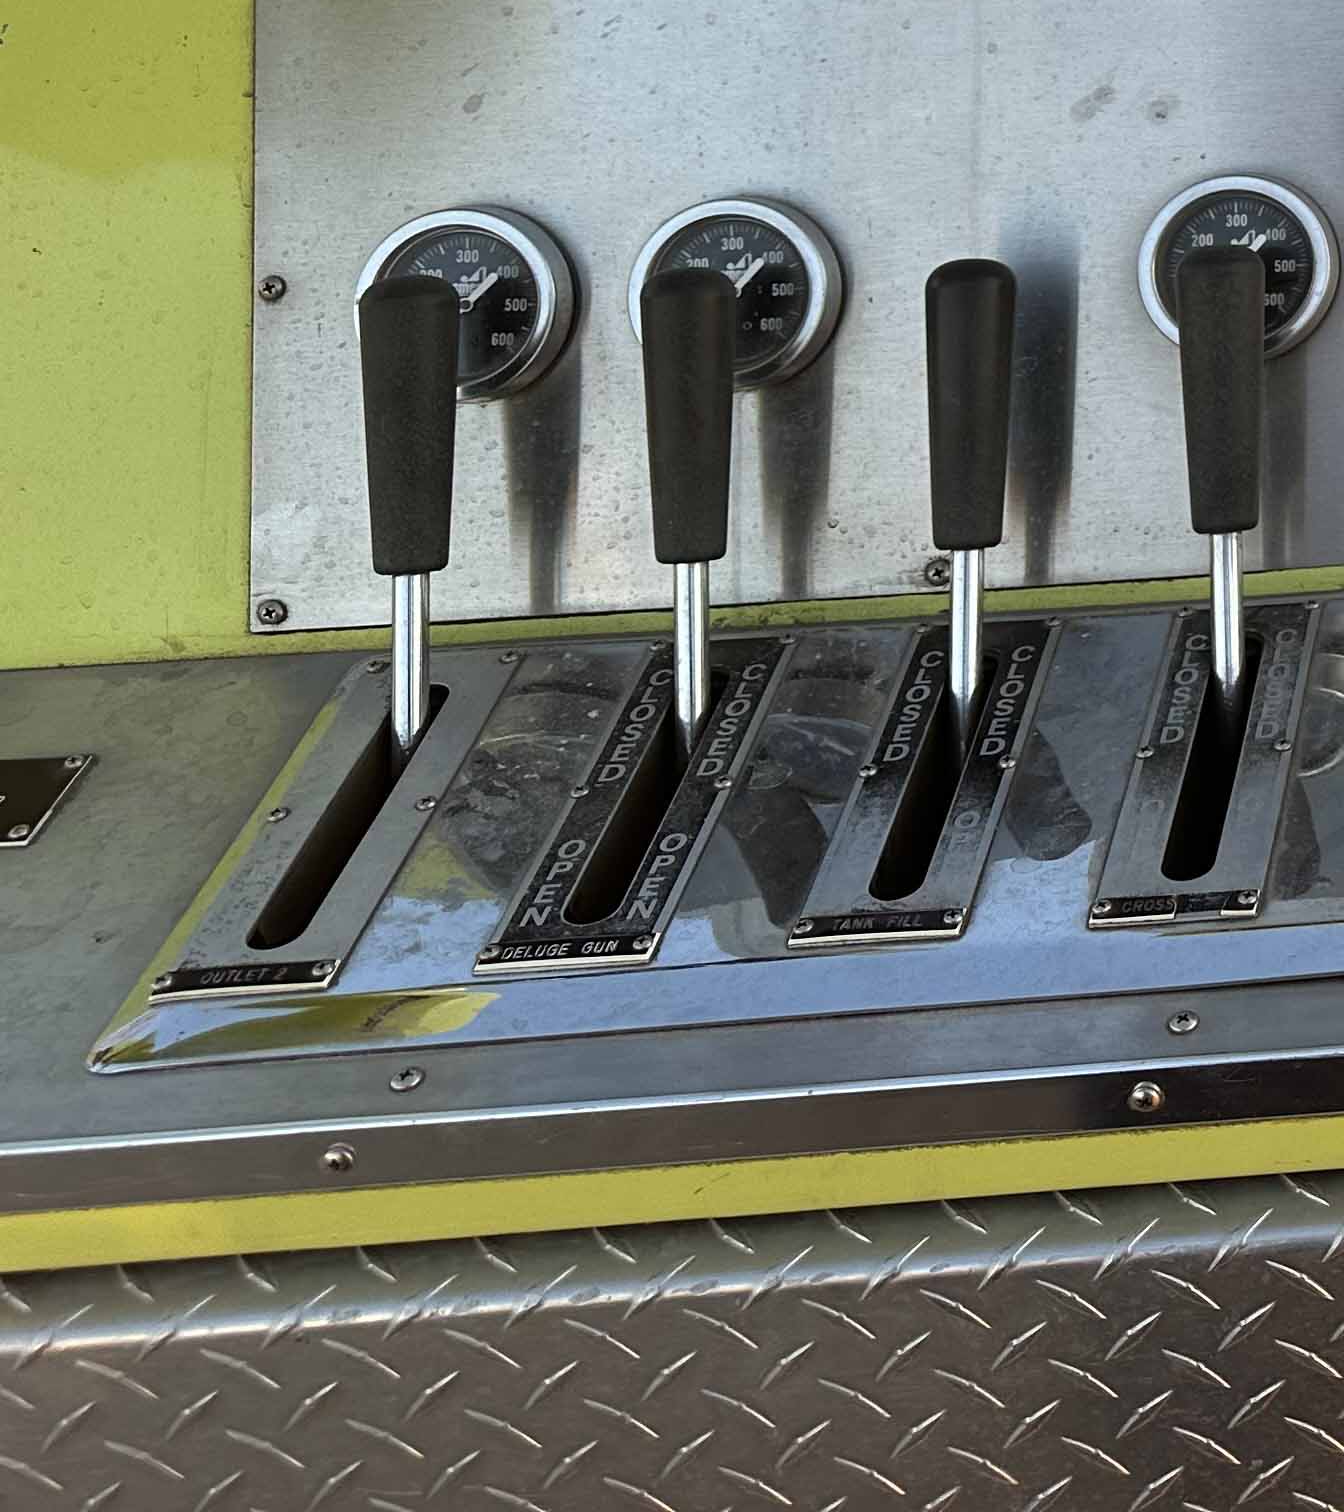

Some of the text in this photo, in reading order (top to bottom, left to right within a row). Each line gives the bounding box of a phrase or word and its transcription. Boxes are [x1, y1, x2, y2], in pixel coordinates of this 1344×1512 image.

[1225, 214, 1248, 228] 300
[721, 236, 744, 251] 300
[1191, 233, 1214, 247] 200
[456, 249, 480, 263] 300
[1274, 259, 1296, 273] 500
[771, 283, 795, 297] 500
[504, 298, 528, 312] 500
[760, 317, 783, 331] 600
[491, 332, 515, 346] 600
[1160, 635, 1209, 744] CLOSED
[1255, 628, 1298, 742] CLOSED
[882, 650, 945, 762] CLOSED
[979, 645, 1035, 757] CLOSED
[599, 669, 674, 782] CLOSED
[696, 664, 768, 777] CLOSED
[519, 839, 586, 927] OPEN
[626, 833, 688, 920] OPEN
[1121, 897, 1176, 914] CROSS
[832, 915, 924, 931] TANK FILL
[501, 940, 620, 961] DELUGE GUN
[201, 968, 272, 985] OUTLET
